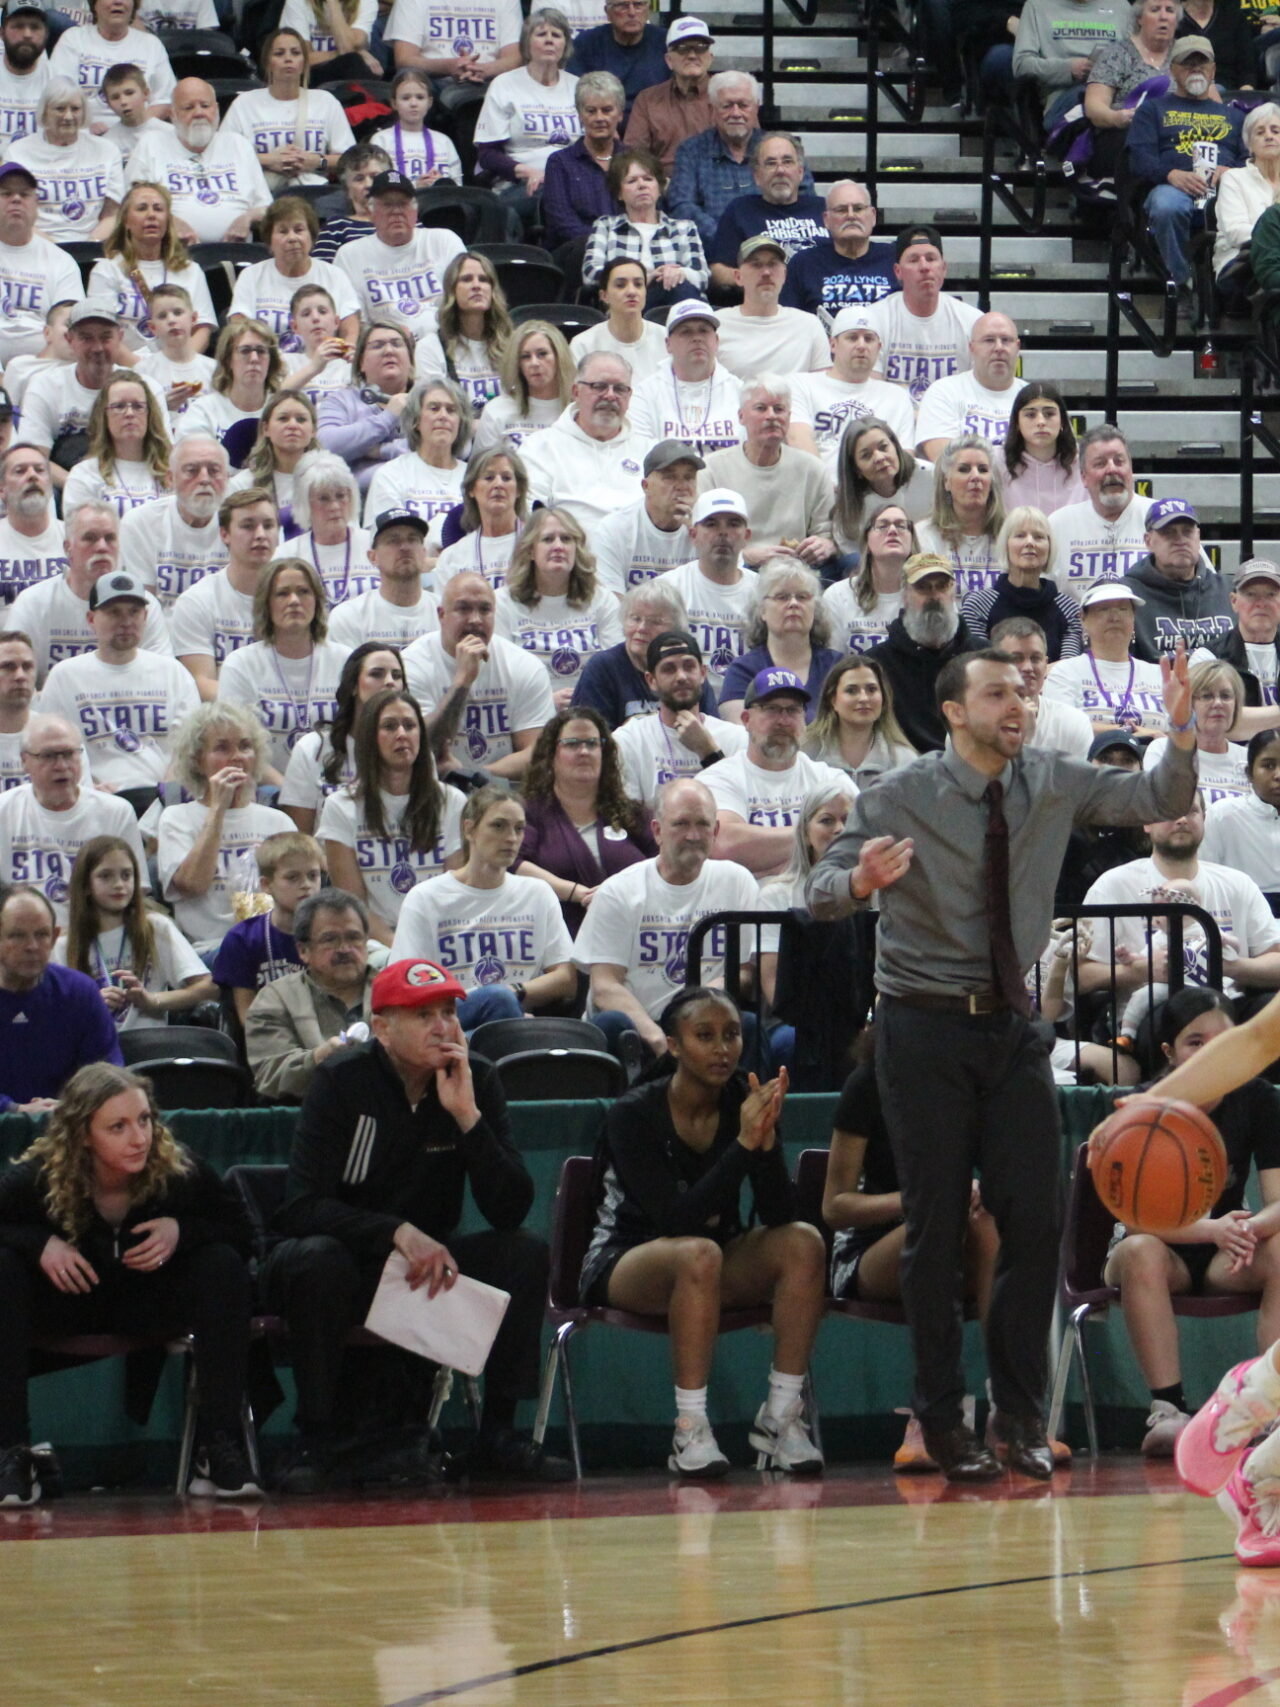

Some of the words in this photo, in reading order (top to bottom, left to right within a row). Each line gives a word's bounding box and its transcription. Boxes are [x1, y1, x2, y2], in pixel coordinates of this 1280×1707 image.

[429, 17, 497, 40] STATE
[0, 109, 38, 133] TAT
[523, 111, 584, 136] STAT
[37, 176, 106, 202] STATE
[168, 171, 239, 193] STATE
[760, 224, 829, 240] CHRISTIAN
[765, 217, 817, 232] LYNDEN
[366, 271, 443, 305] STATE
[821, 284, 891, 302] STATE
[823, 275, 851, 287] 2024
[853, 276, 889, 287] LYNCS
[3, 281, 44, 310] ATE
[887, 355, 958, 382] STATE
[460, 377, 501, 401] TAT
[963, 413, 1010, 436] STA
[405, 500, 459, 521] STA
[1160, 499, 1186, 515] NV
[1067, 551, 1149, 577] STATE
[157, 565, 218, 595] STA
[323, 576, 382, 601] TATE
[953, 569, 1001, 597] TAT
[688, 623, 745, 656] TAT
[766, 671, 797, 688] NV
[80, 705, 167, 738] STATE
[465, 704, 511, 734] ATE
[12, 850, 75, 881] STA
[438, 930, 536, 967] STATE
[639, 925, 726, 963] STAE
